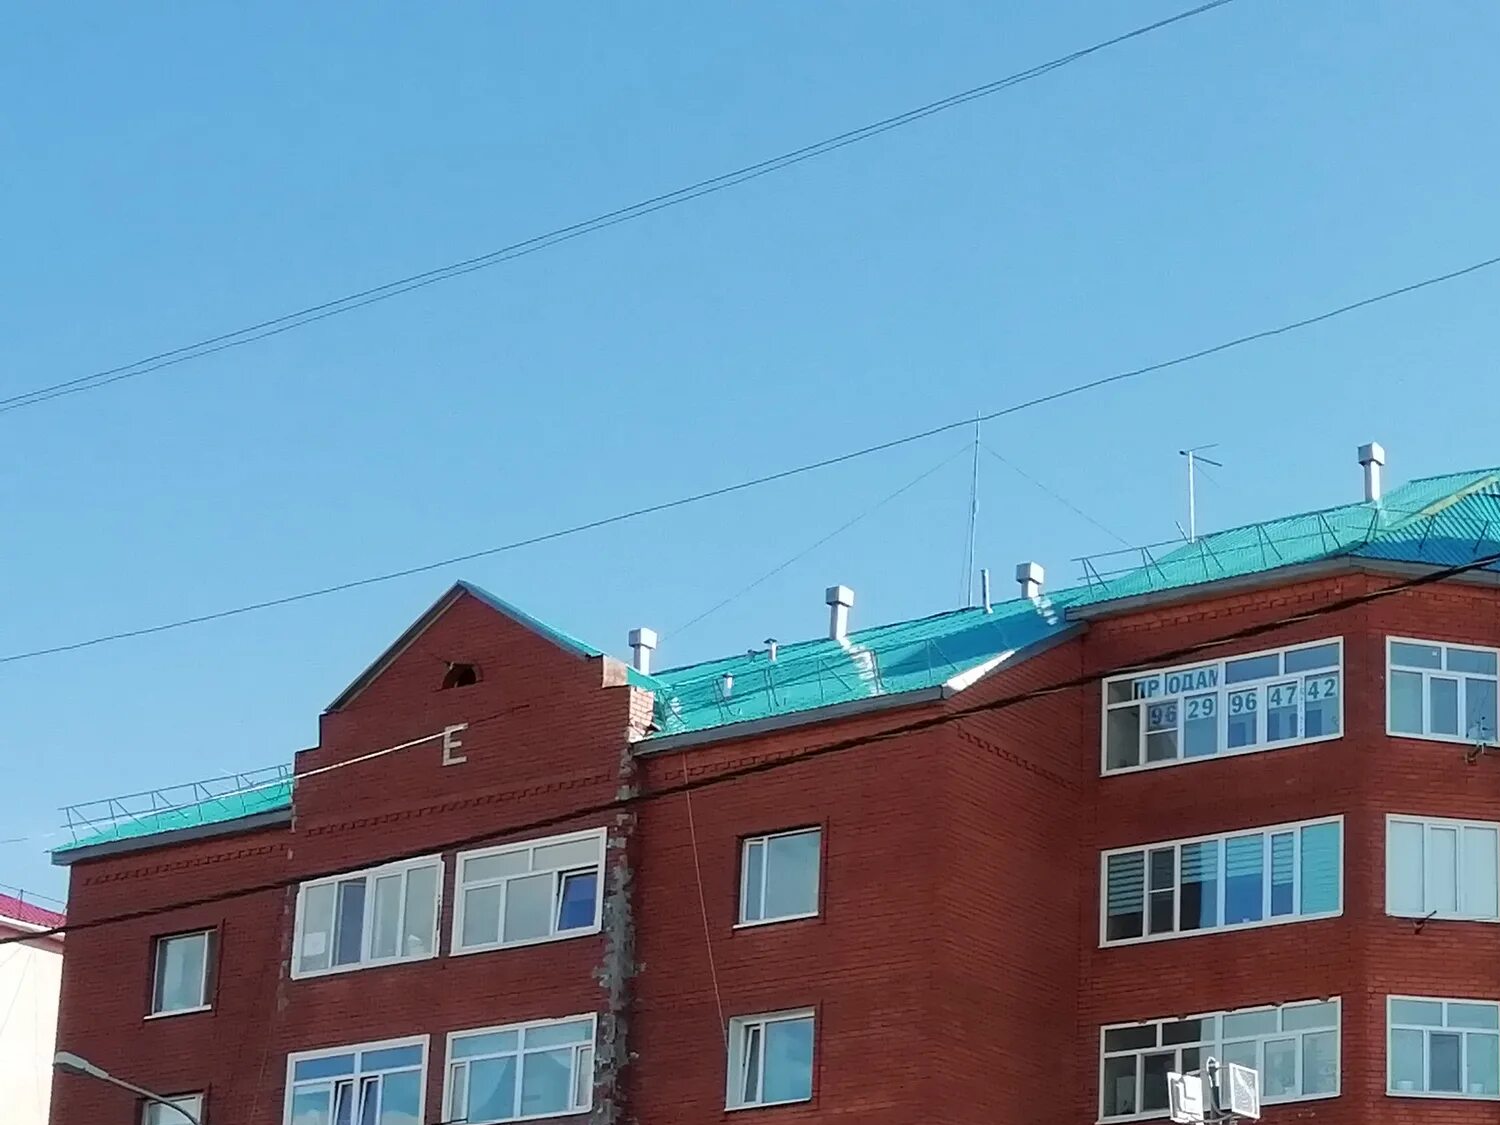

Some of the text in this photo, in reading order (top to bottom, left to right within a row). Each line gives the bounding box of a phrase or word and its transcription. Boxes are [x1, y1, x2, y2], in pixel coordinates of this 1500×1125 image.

[1187, 699, 1214, 719] 29
[1231, 692, 1257, 713] 96
[1270, 685, 1298, 706] 47
[1307, 679, 1336, 699] 42
